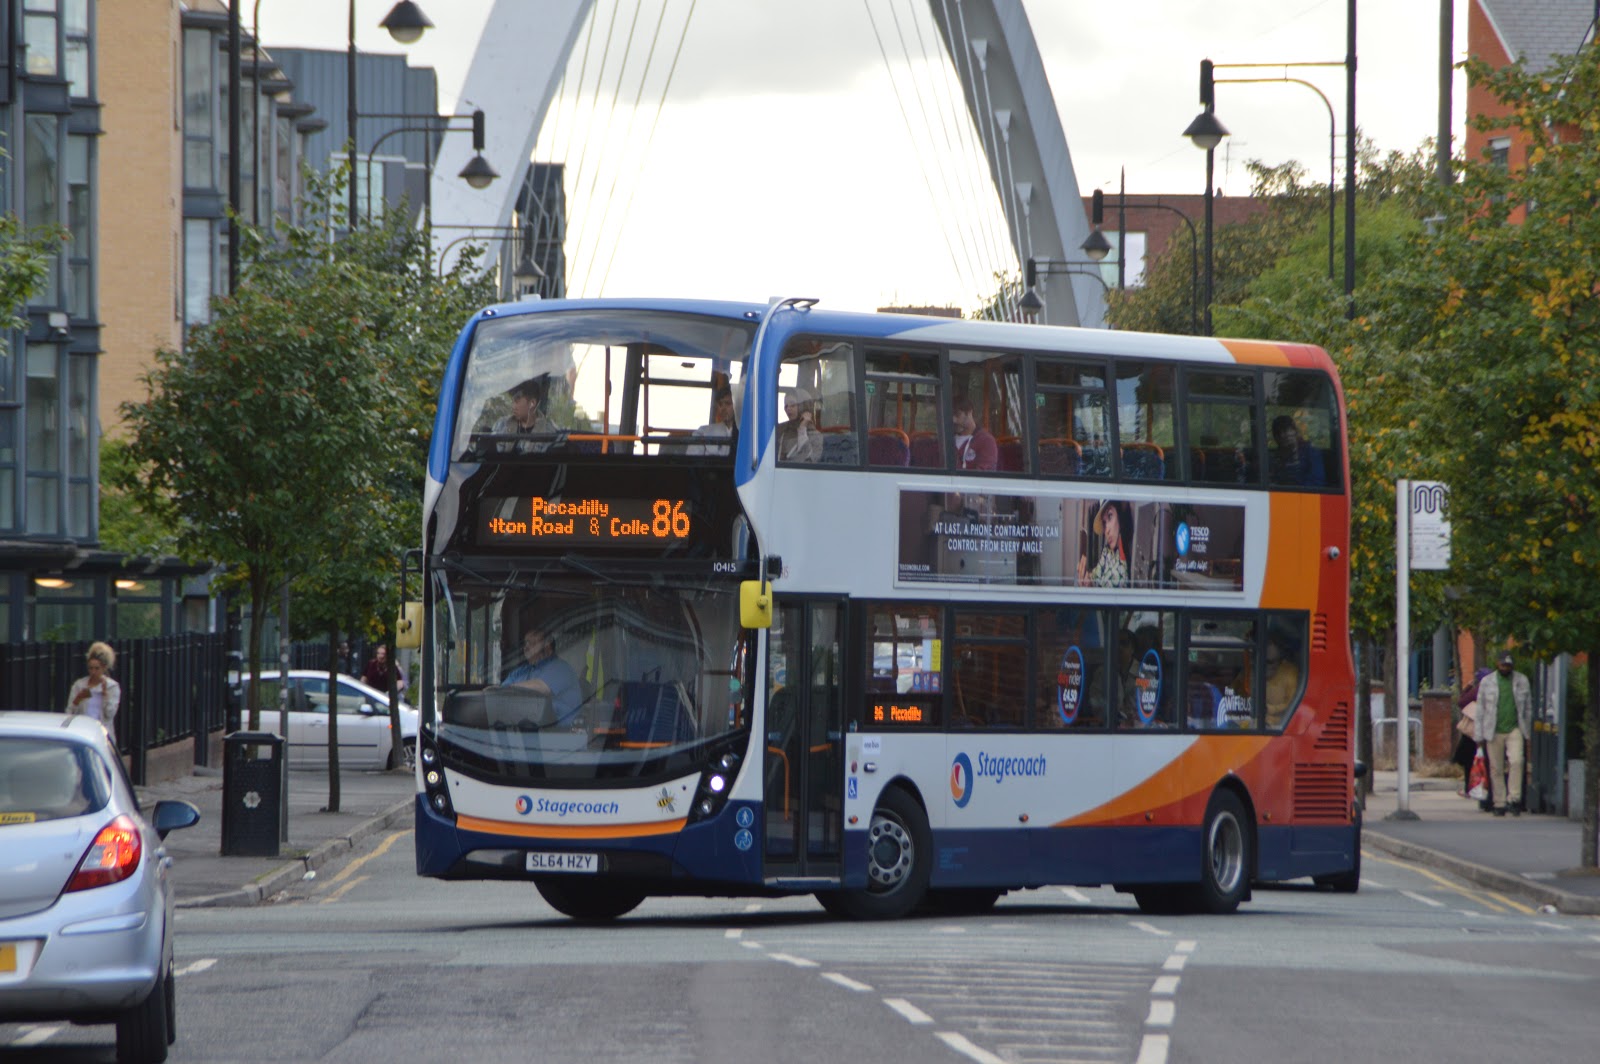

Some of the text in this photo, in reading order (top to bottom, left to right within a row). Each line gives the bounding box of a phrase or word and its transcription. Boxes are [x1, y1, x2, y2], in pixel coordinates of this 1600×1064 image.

[532, 497, 609, 517] Piccadilly
[652, 499, 690, 537] 86
[532, 516, 574, 536] Road
[589, 517, 600, 536] &
[610, 517, 650, 537] Colle
[935, 523, 943, 534] AT
[964, 524, 969, 535] A
[970, 524, 993, 536] PHONE
[994, 525, 1029, 537] CONTRACT
[1031, 526, 1044, 537] YOU
[1045, 526, 1059, 537] CAN
[1190, 526, 1210, 537] TESCO
[948, 539, 1043, 553] CONTROL FROM EVERY ANGLE
[713, 562, 737, 573] 10415
[977, 751, 1046, 784] Stagecoach
[537, 798, 619, 816] Stagecoach
[532, 854, 592, 869] SL64 HZY
